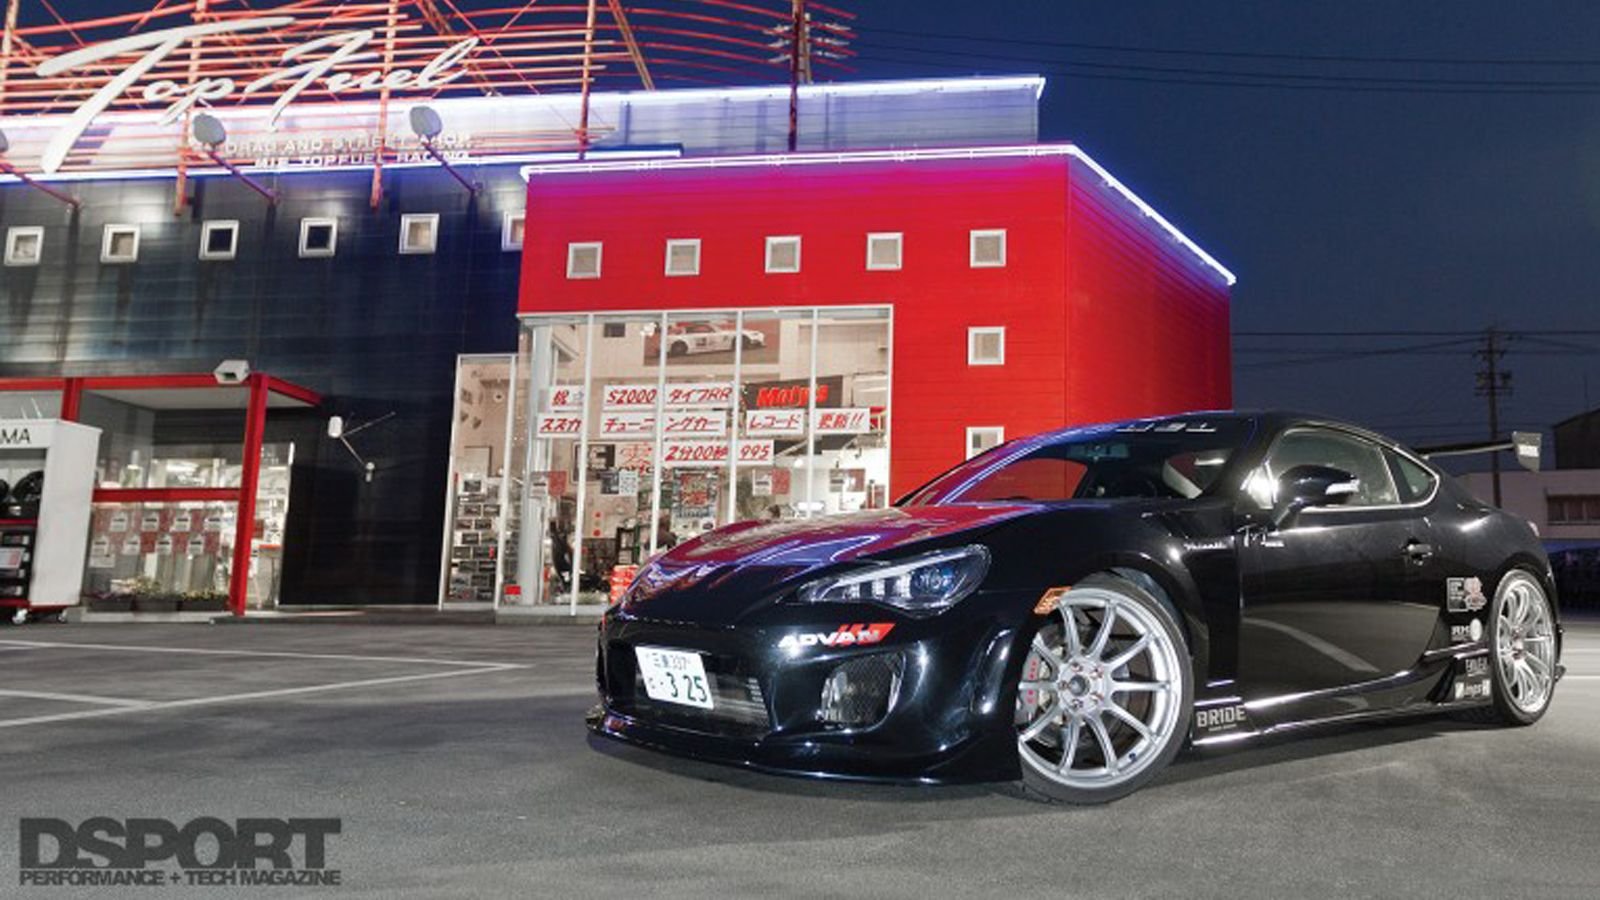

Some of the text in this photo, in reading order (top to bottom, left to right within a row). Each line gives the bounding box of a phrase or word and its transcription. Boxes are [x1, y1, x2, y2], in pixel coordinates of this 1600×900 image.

[36, 16, 479, 174] Top Fuel
[284, 137, 323, 153] AND
[397, 150, 469, 163] RACNG
[606, 388, 658, 405] S2000
[750, 413, 801, 429] レコード
[740, 444, 771, 461] 995
[777, 629, 881, 649] ADVAN
[1195, 704, 1247, 728] BRIDE
